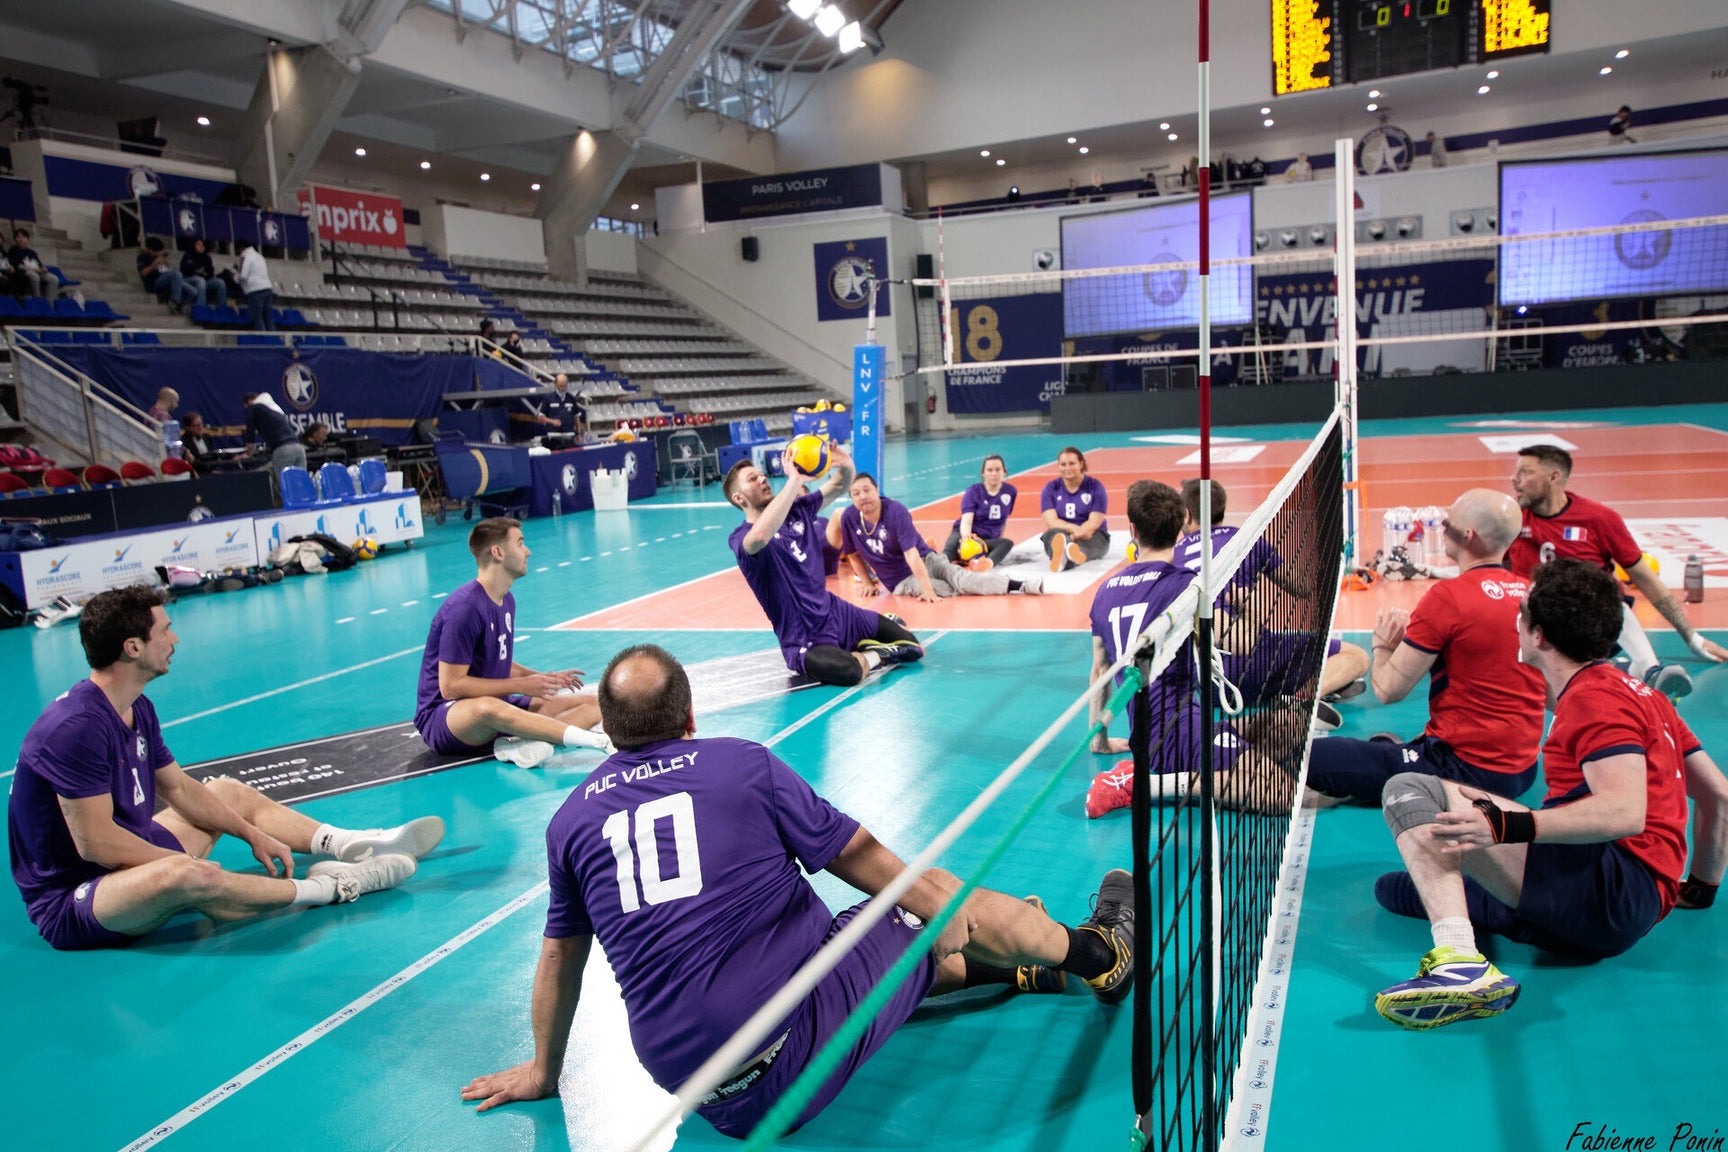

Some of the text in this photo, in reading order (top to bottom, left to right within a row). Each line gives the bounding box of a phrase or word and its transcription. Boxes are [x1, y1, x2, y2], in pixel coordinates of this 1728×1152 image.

[752, 177, 829, 195] PARIS VOLLEY
[948, 366, 1006, 377] CHAMPIONS
[950, 375, 1001, 386] DE FRANCE
[1065, 502, 1076, 518] 8
[1540, 541, 1556, 564] 6
[102, 561, 142, 574] HYDRASCORE
[36, 571, 80, 586] HYDRASCORE
[1108, 602, 1149, 662] 17
[584, 751, 699, 800] PUC VOLLEY
[602, 791, 703, 914] 10
